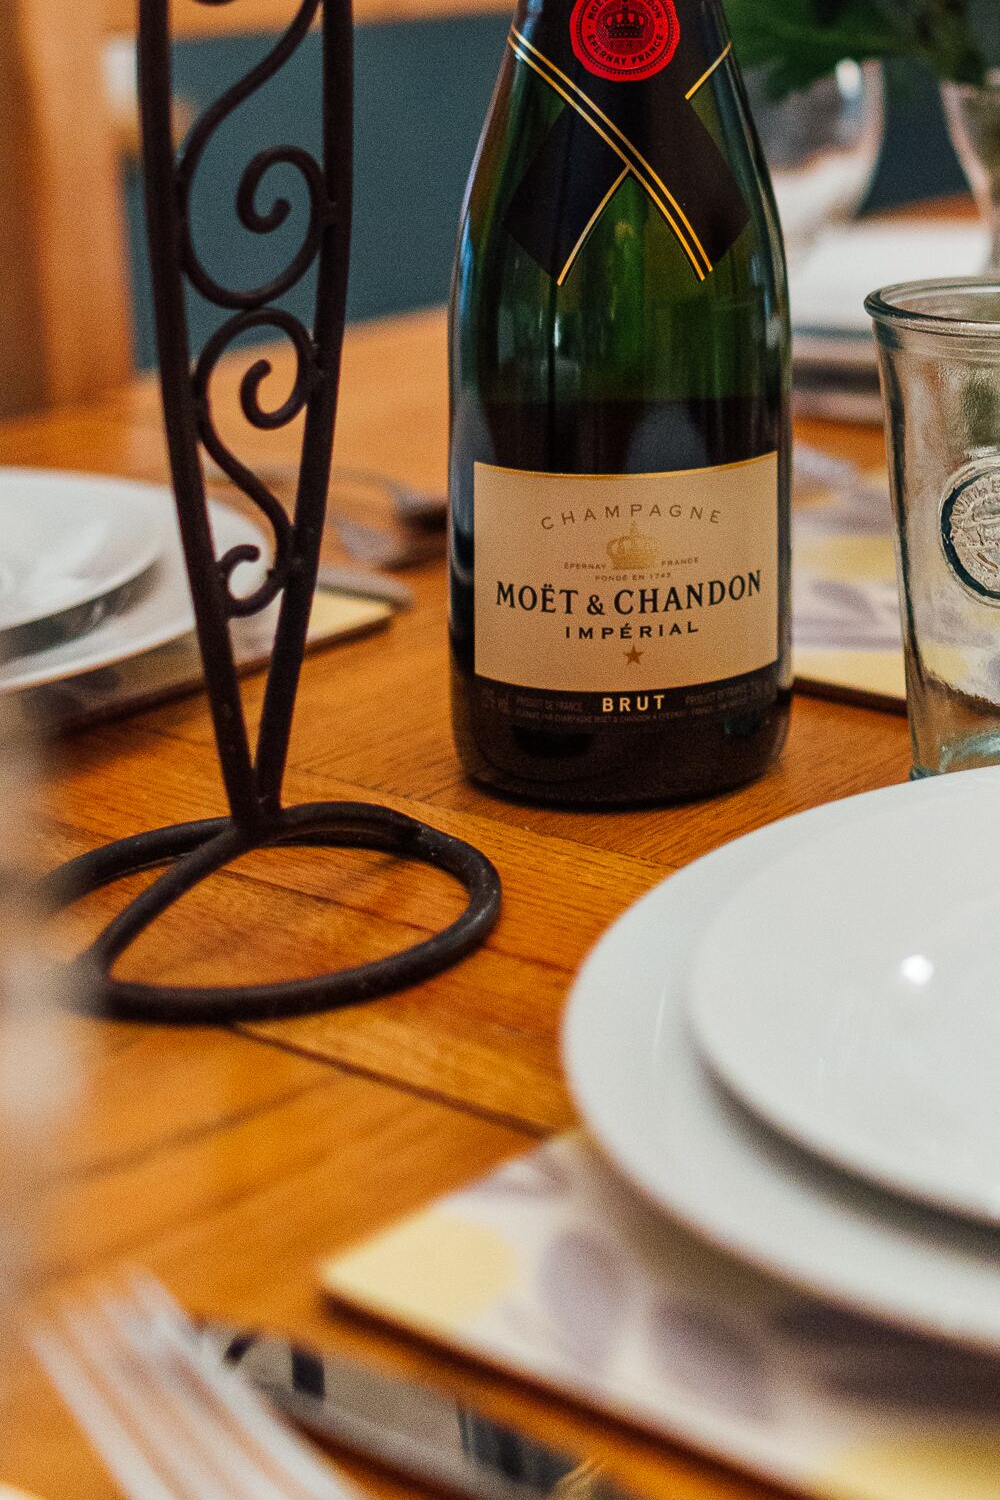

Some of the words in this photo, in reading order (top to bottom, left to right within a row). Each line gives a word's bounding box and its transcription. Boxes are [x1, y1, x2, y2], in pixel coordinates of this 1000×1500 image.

[631, 35, 663, 64] FRANCE
[541, 503, 722, 531] CHAMPAGNE
[661, 557, 699, 567] FRANCE
[496, 580, 579, 614] MOËT
[586, 594, 606, 616] &
[614, 569, 763, 615] CHANDON
[564, 621, 700, 640] IMPÉRIAL
[602, 694, 666, 713] BRUT
